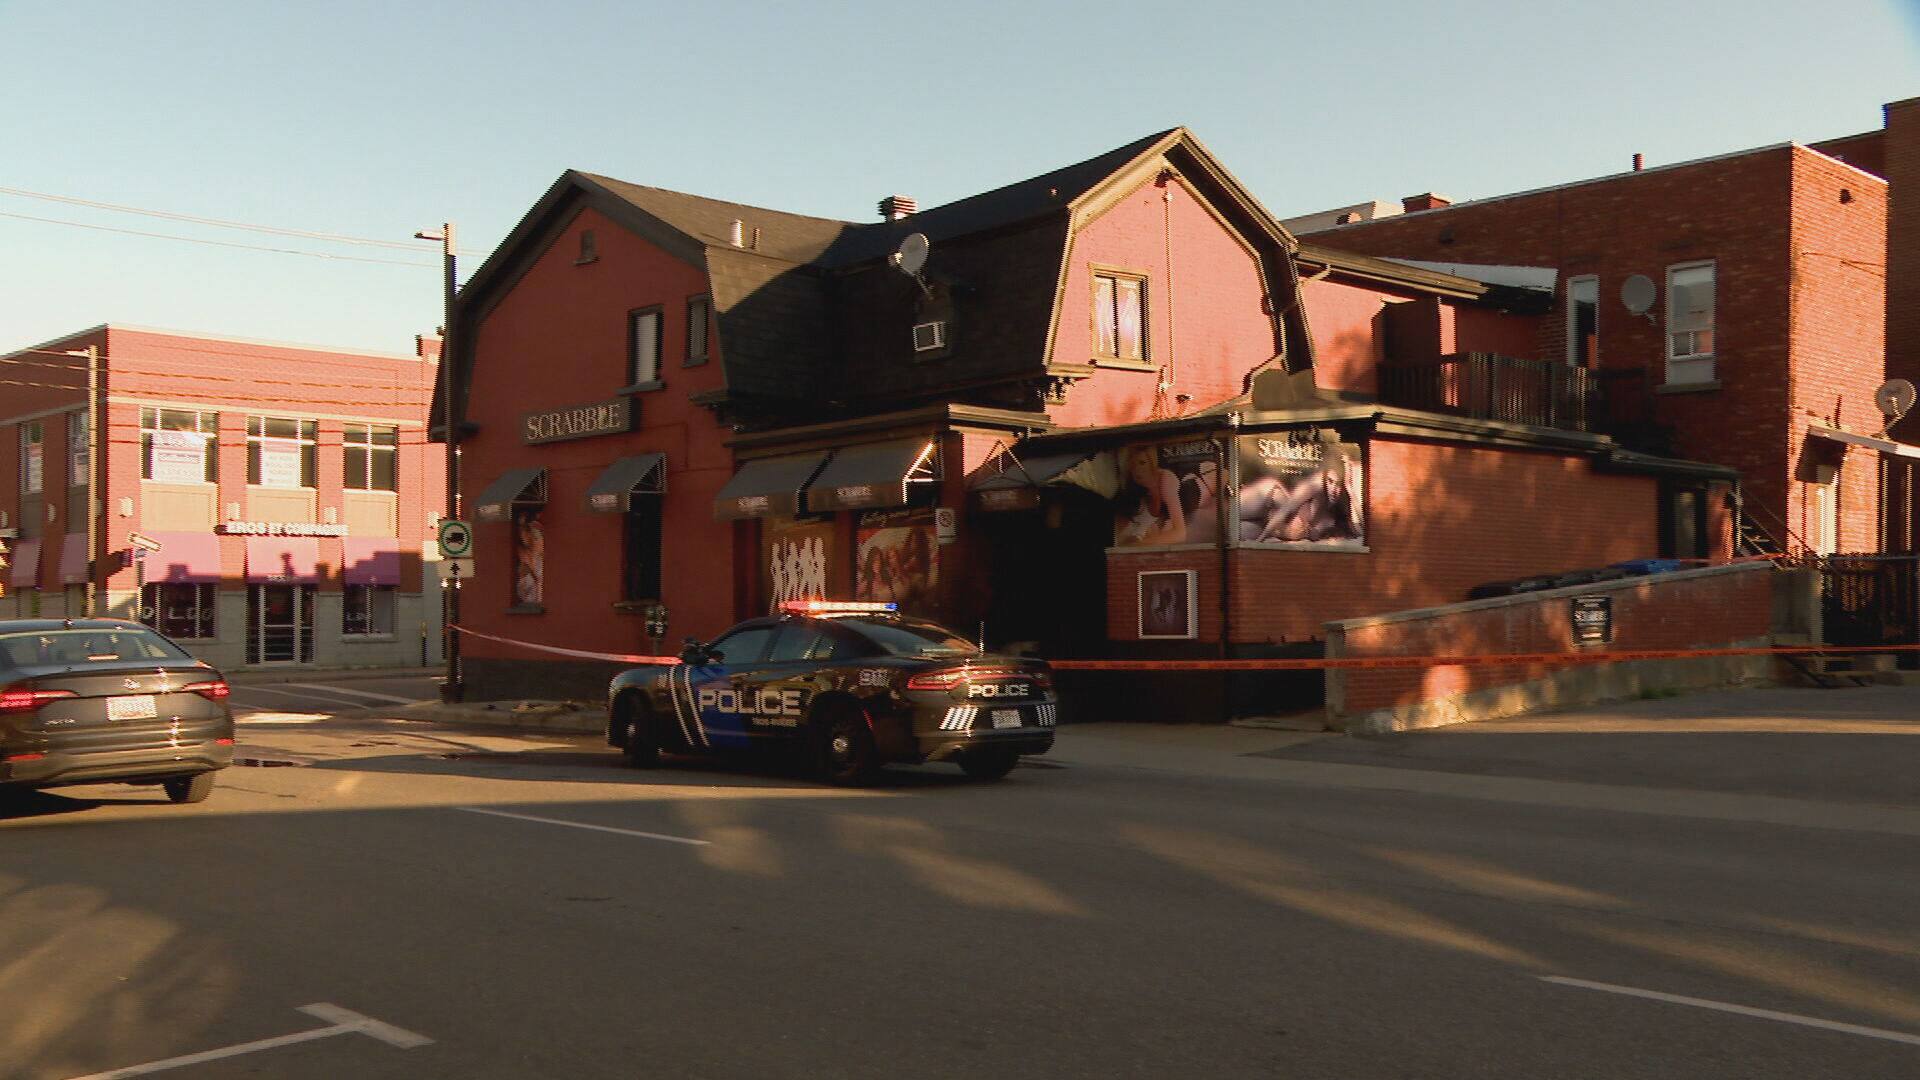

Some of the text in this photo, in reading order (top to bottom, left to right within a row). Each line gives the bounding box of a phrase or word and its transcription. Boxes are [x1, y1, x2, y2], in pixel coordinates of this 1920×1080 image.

[527, 403, 622, 440] SCRABBLE
[1258, 439, 1324, 462] SCRABBLE
[225, 522, 350, 537] EROS ET COMPAGNIE
[859, 669, 889, 687] 911
[968, 684, 1029, 699] POLICE
[698, 689, 802, 716] POLICE
